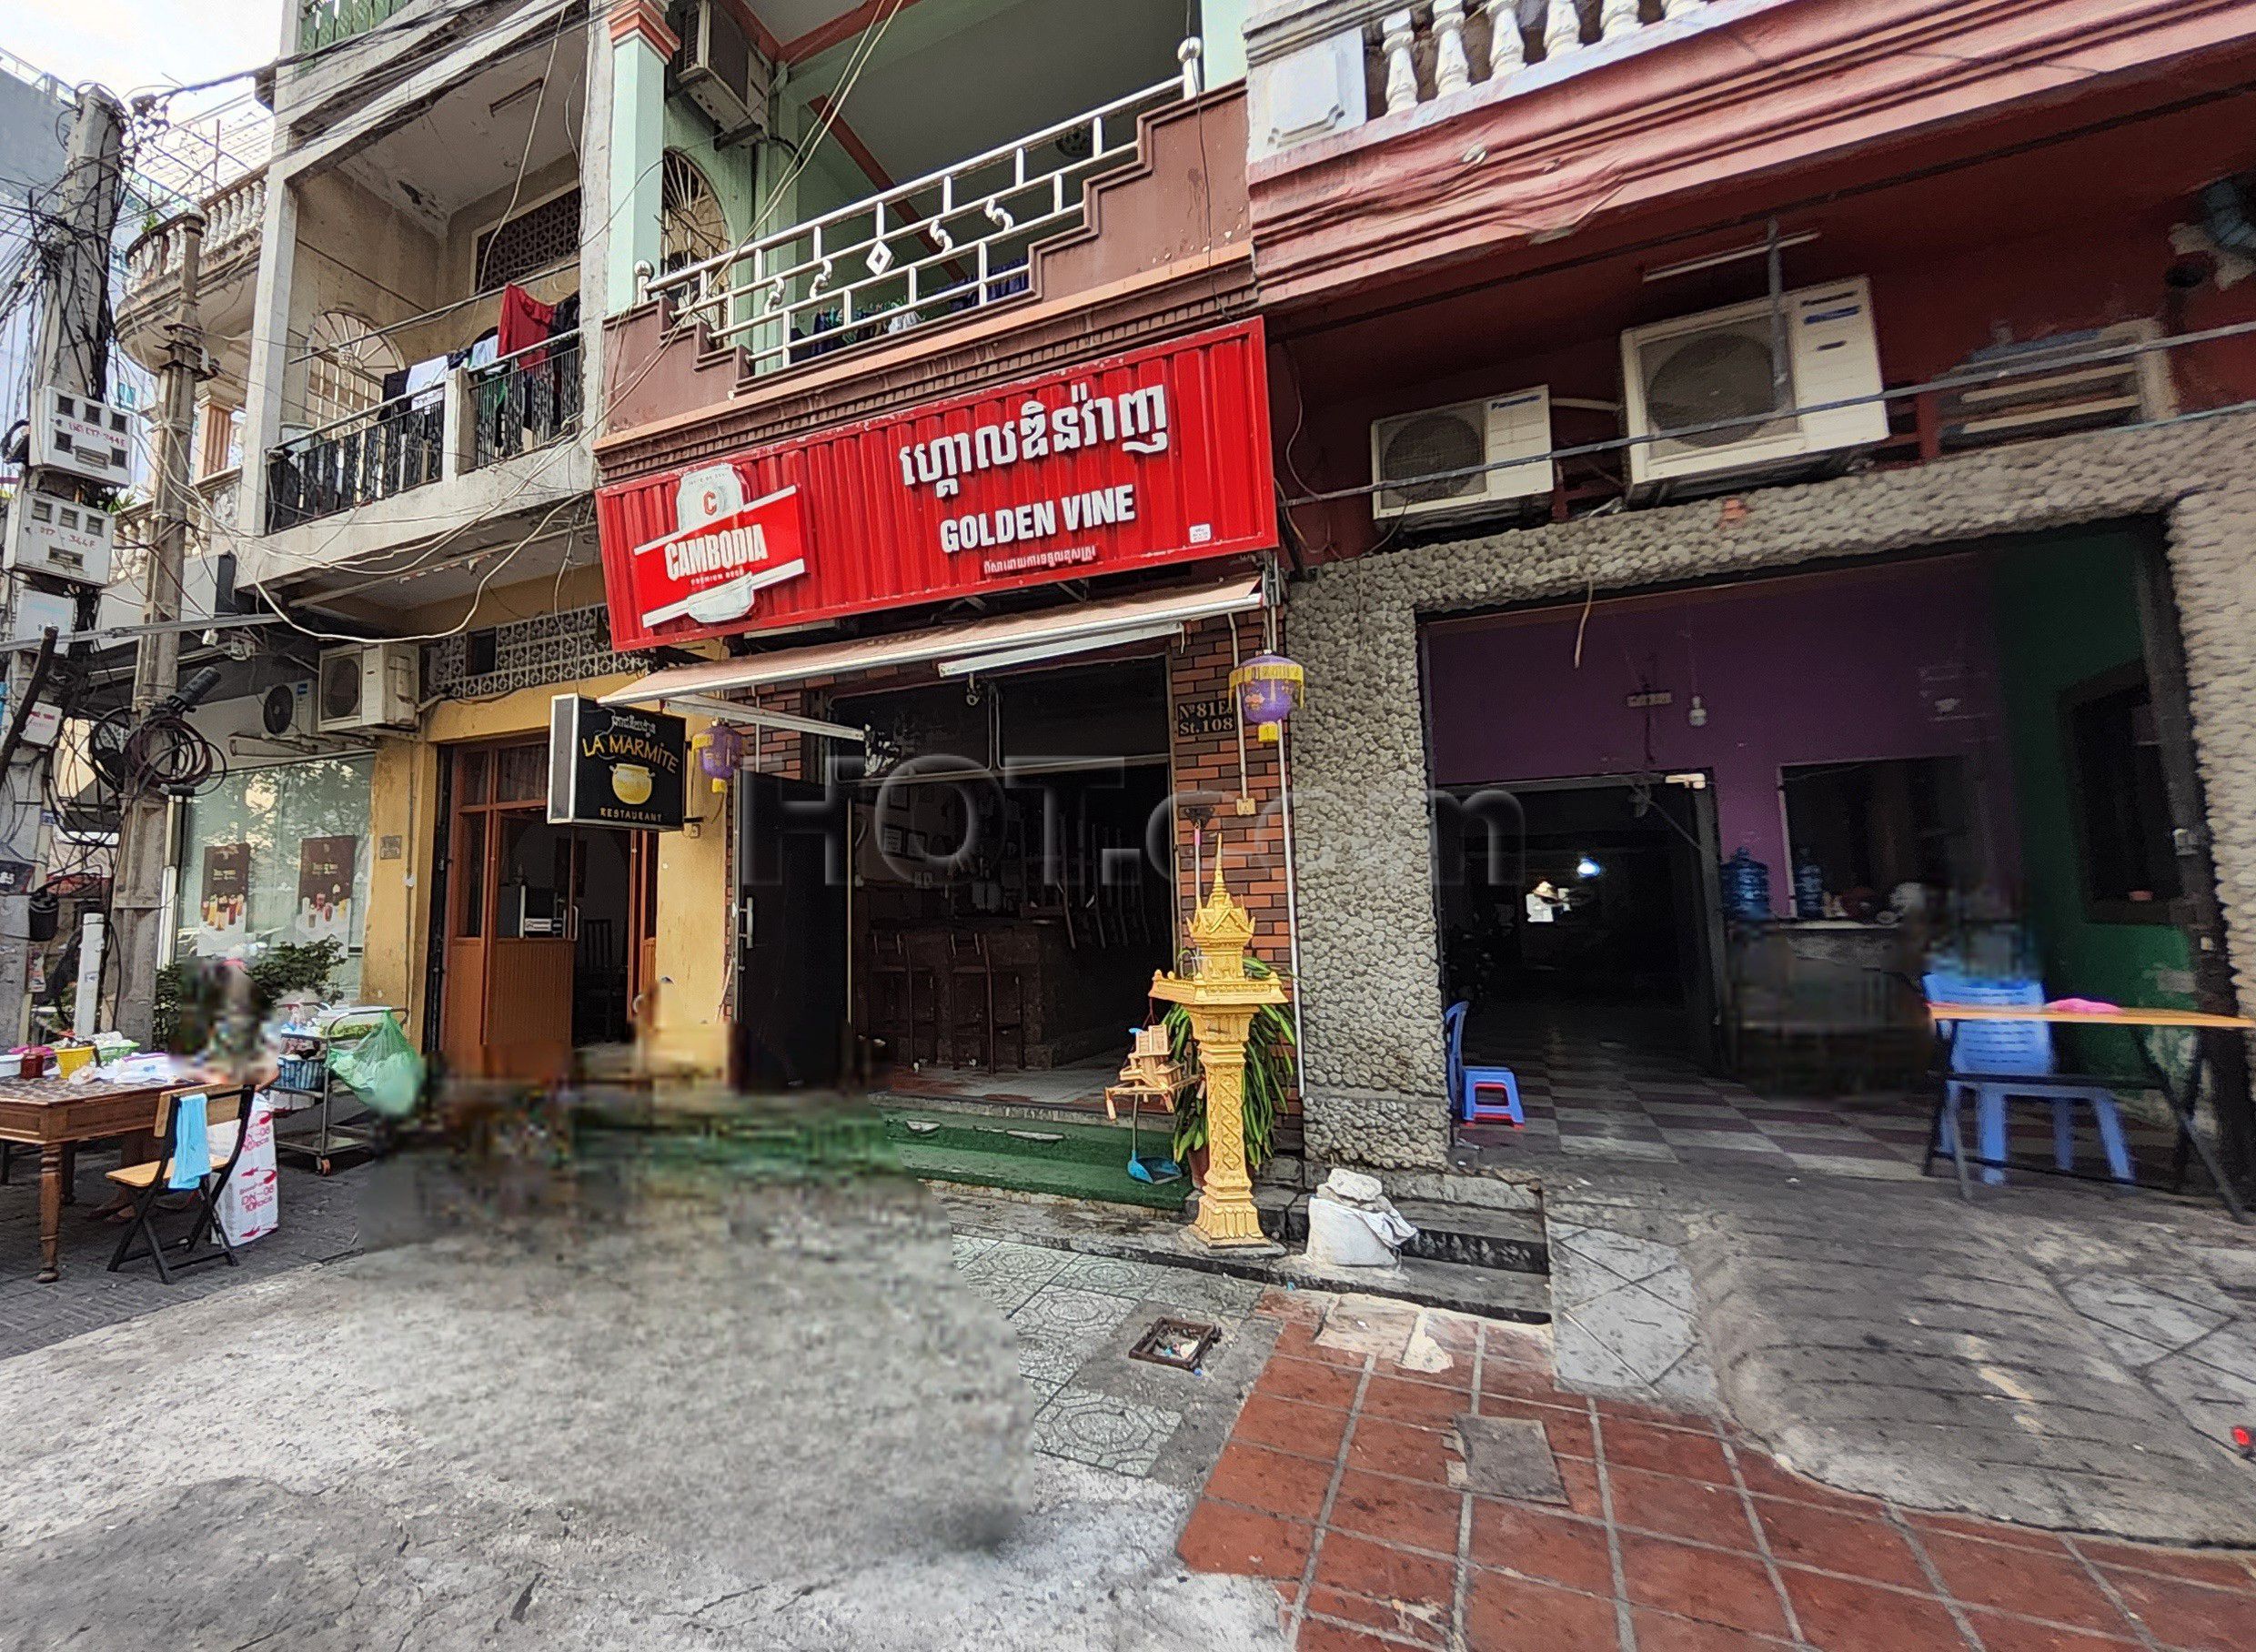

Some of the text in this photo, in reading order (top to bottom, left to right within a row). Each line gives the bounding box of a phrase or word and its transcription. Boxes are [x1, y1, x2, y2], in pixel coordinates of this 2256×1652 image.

[703, 491, 717, 515] C
[940, 484, 1135, 553] GOLDEN VINE
[664, 523, 769, 581] CAMBODIA
[1179, 717, 1234, 735] St. 108
[582, 734, 605, 757] LA
[600, 807, 661, 821] RESTAURANT
